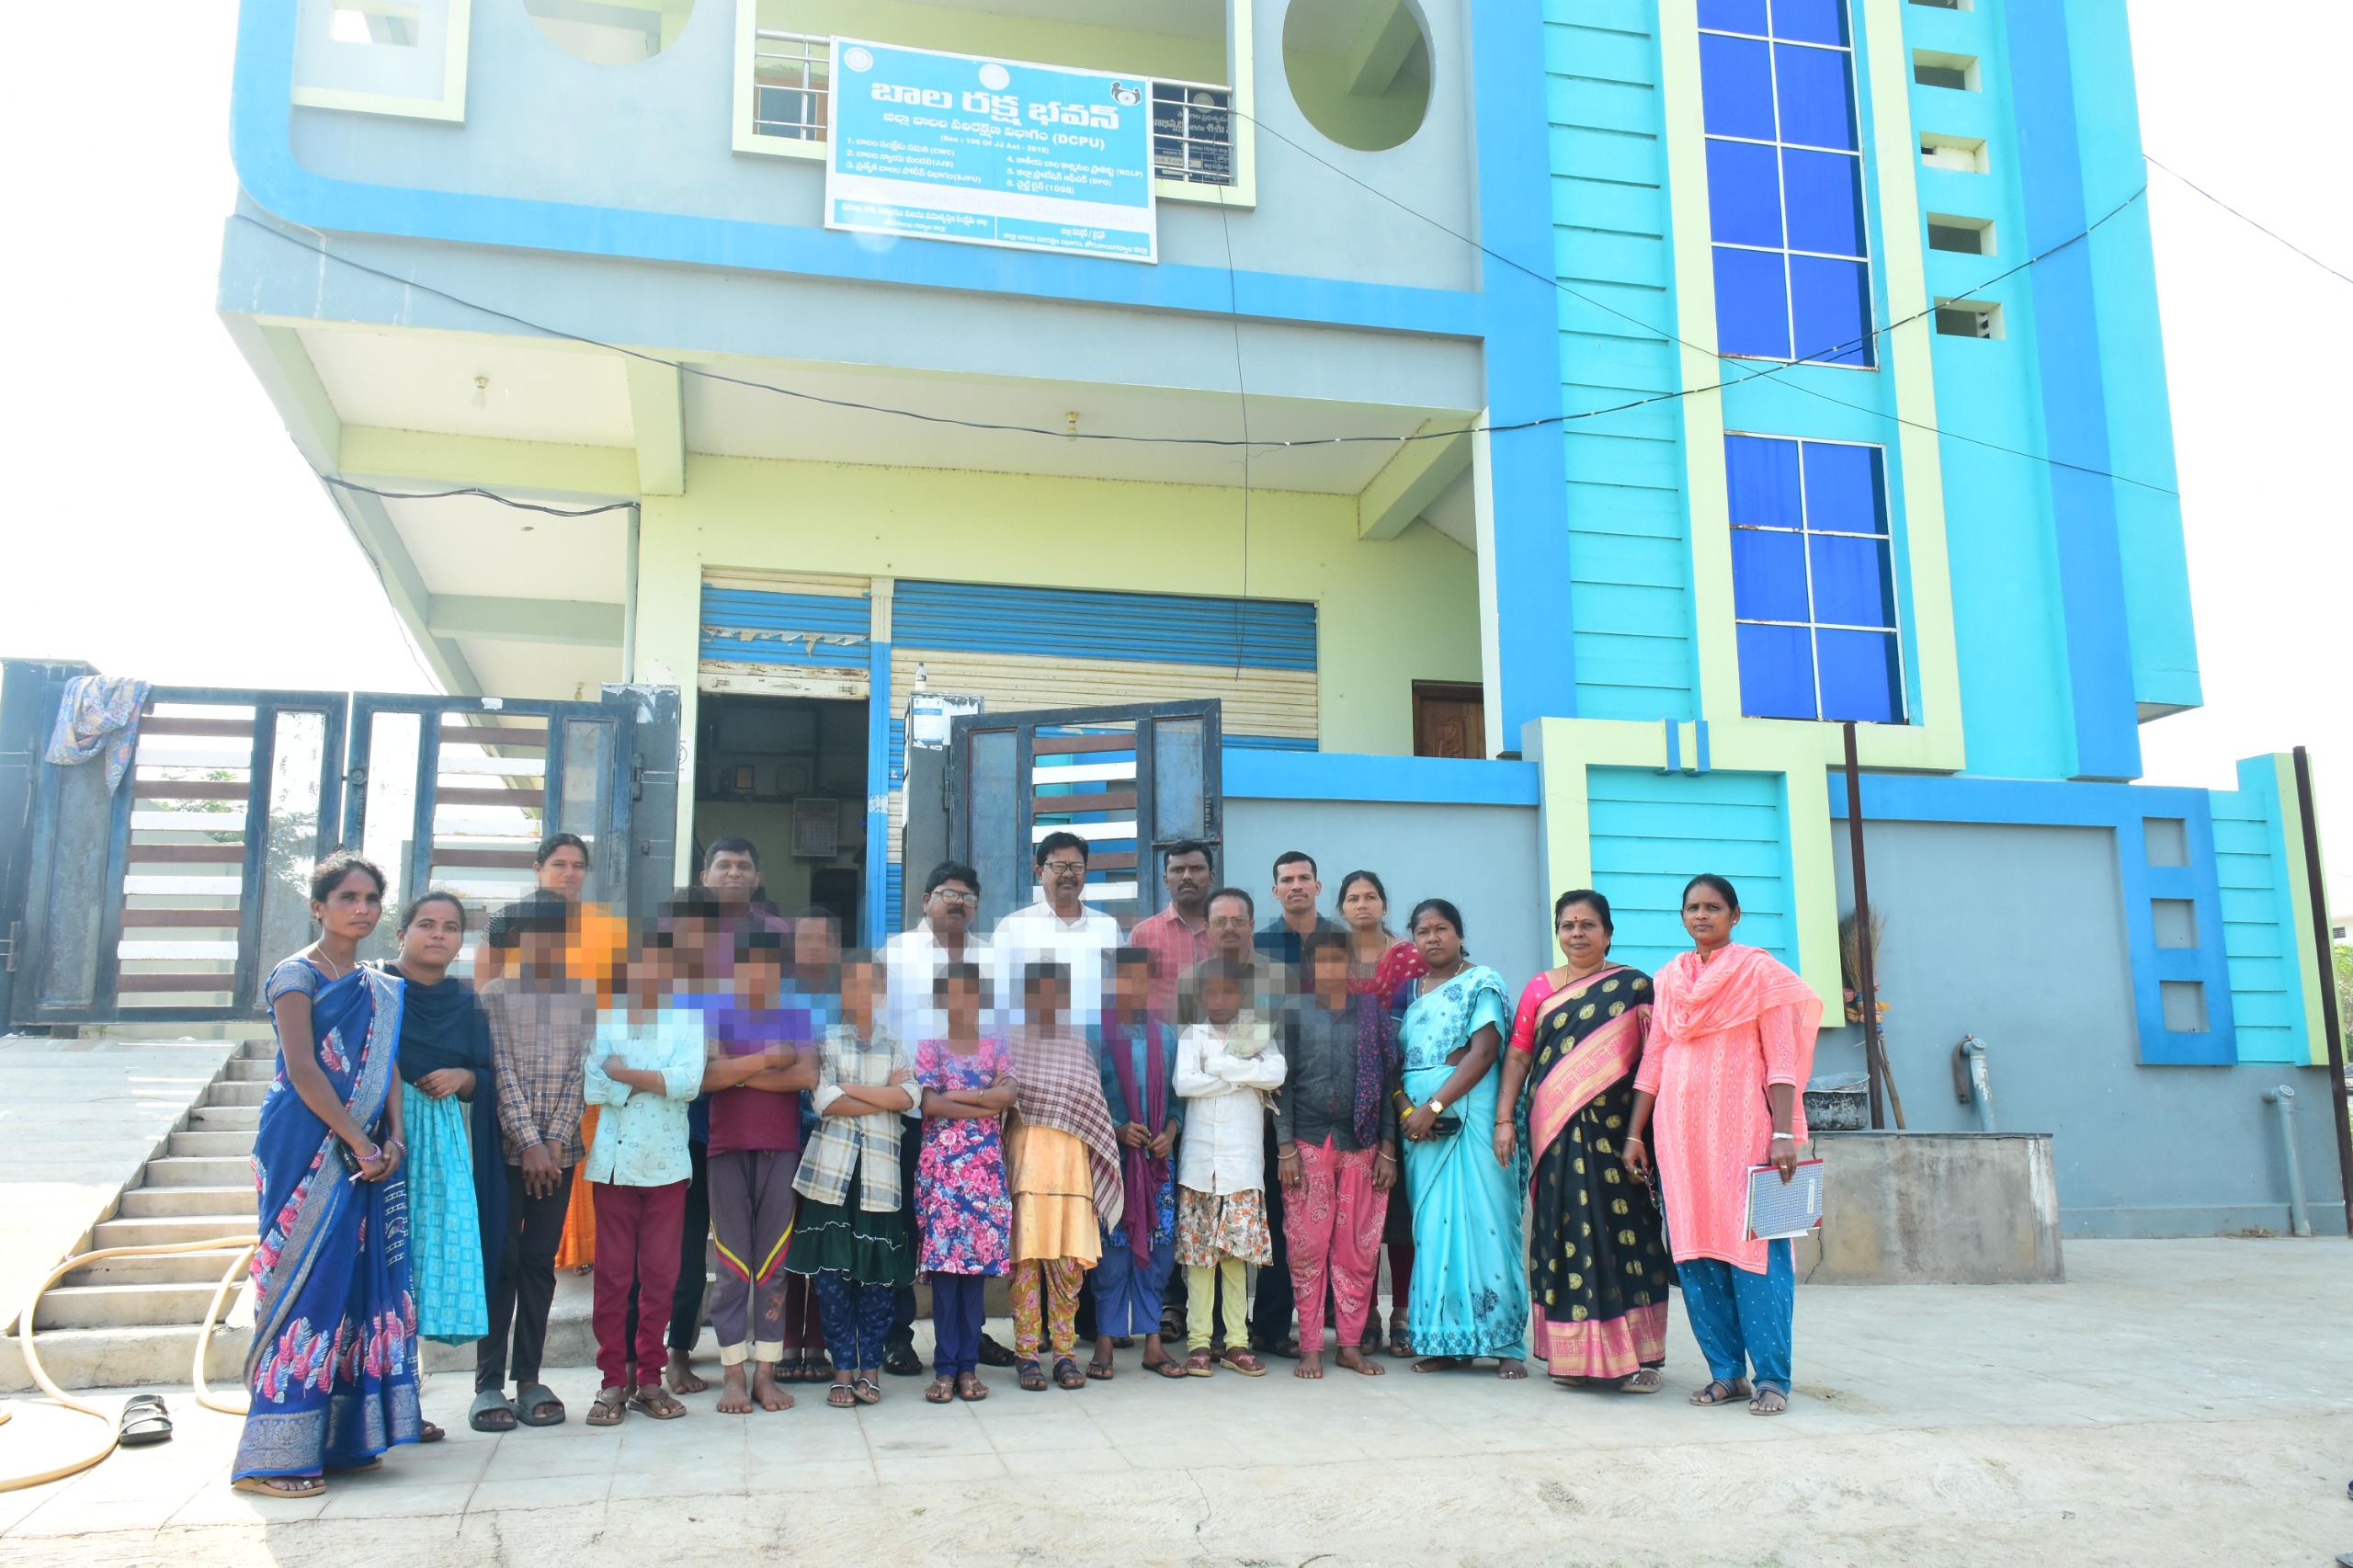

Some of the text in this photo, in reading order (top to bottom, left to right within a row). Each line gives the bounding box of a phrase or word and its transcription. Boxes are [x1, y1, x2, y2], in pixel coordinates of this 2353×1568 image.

[871, 82, 1120, 130] బాల రక్ష భవన్
[883, 112, 1105, 151] జిల్లా బాలల పరిరక్షణ విభాగం (DCPU)
[930, 147, 955, 157] (CWC)
[940, 135, 959, 143] (Sec
[1027, 144, 1050, 154] 2015)
[1006, 167, 1015, 176] 5.
[1089, 177, 1112, 187] (DPO)
[1116, 168, 1143, 179] (NCLP)
[1045, 185, 1074, 195] (1098)
